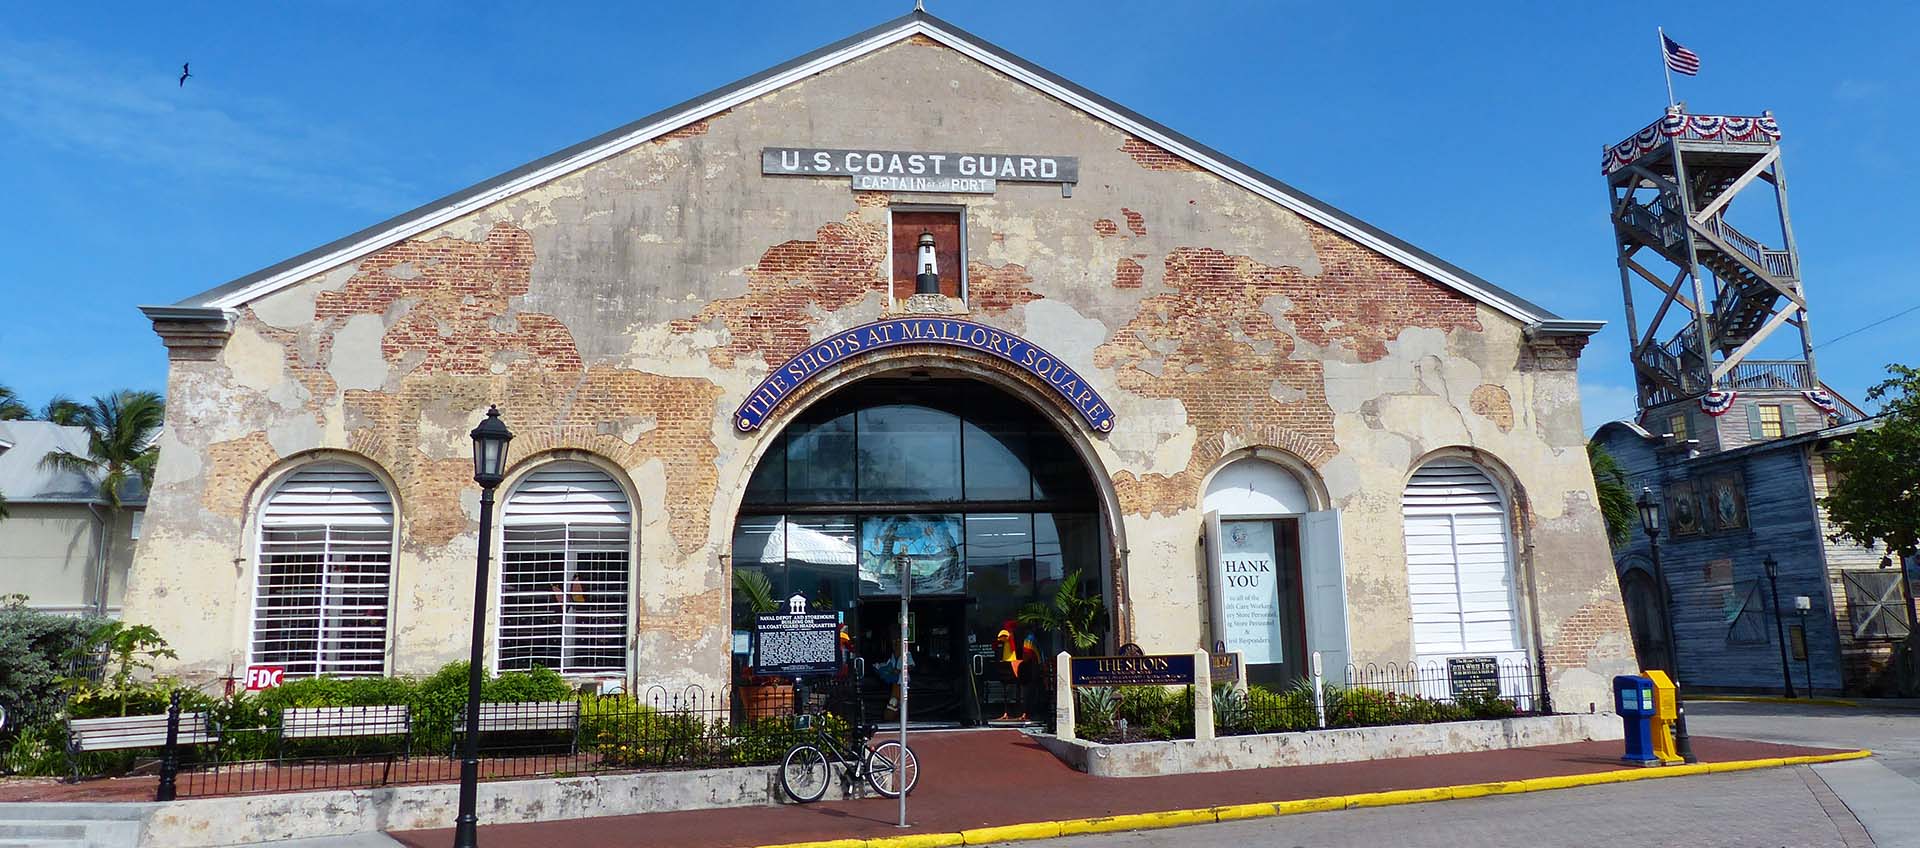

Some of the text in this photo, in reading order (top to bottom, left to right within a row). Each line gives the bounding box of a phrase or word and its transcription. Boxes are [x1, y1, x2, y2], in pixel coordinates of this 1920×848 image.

[959, 156, 1058, 178] GUARD
[862, 176, 926, 190] CAPTAIN
[952, 179, 986, 192] PORT
[745, 322, 1104, 421] THE SHOPS AT MALLORY SQUARE
[1223, 560, 1270, 572] HANK
[1227, 575, 1259, 587] YOU
[1097, 658, 1168, 672] THE SHOPS
[247, 669, 282, 688] FDC
